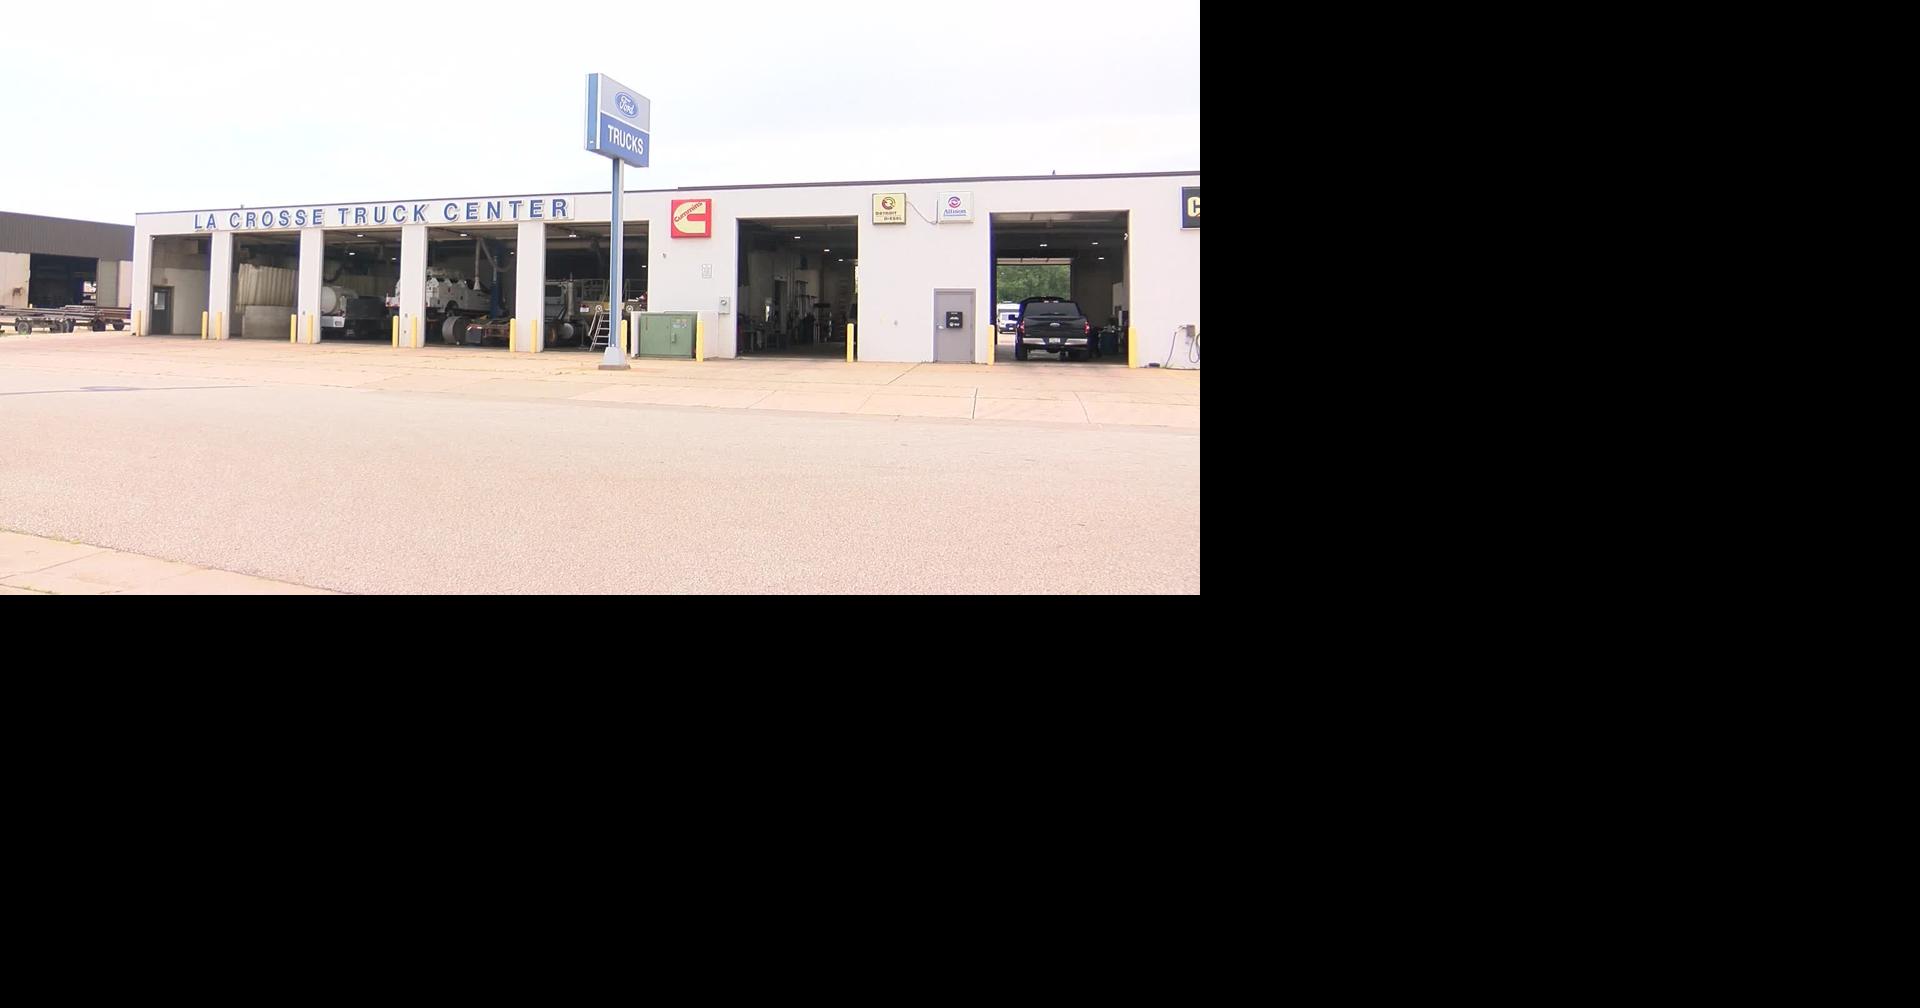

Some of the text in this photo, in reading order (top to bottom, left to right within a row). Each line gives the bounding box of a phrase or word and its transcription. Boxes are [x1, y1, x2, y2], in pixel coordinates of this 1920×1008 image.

[619, 95, 636, 116] Ford
[607, 124, 644, 155] TRUCKS
[194, 198, 567, 229] LA CROSSE TRUCK CENTER
[673, 201, 704, 223] Cummins
